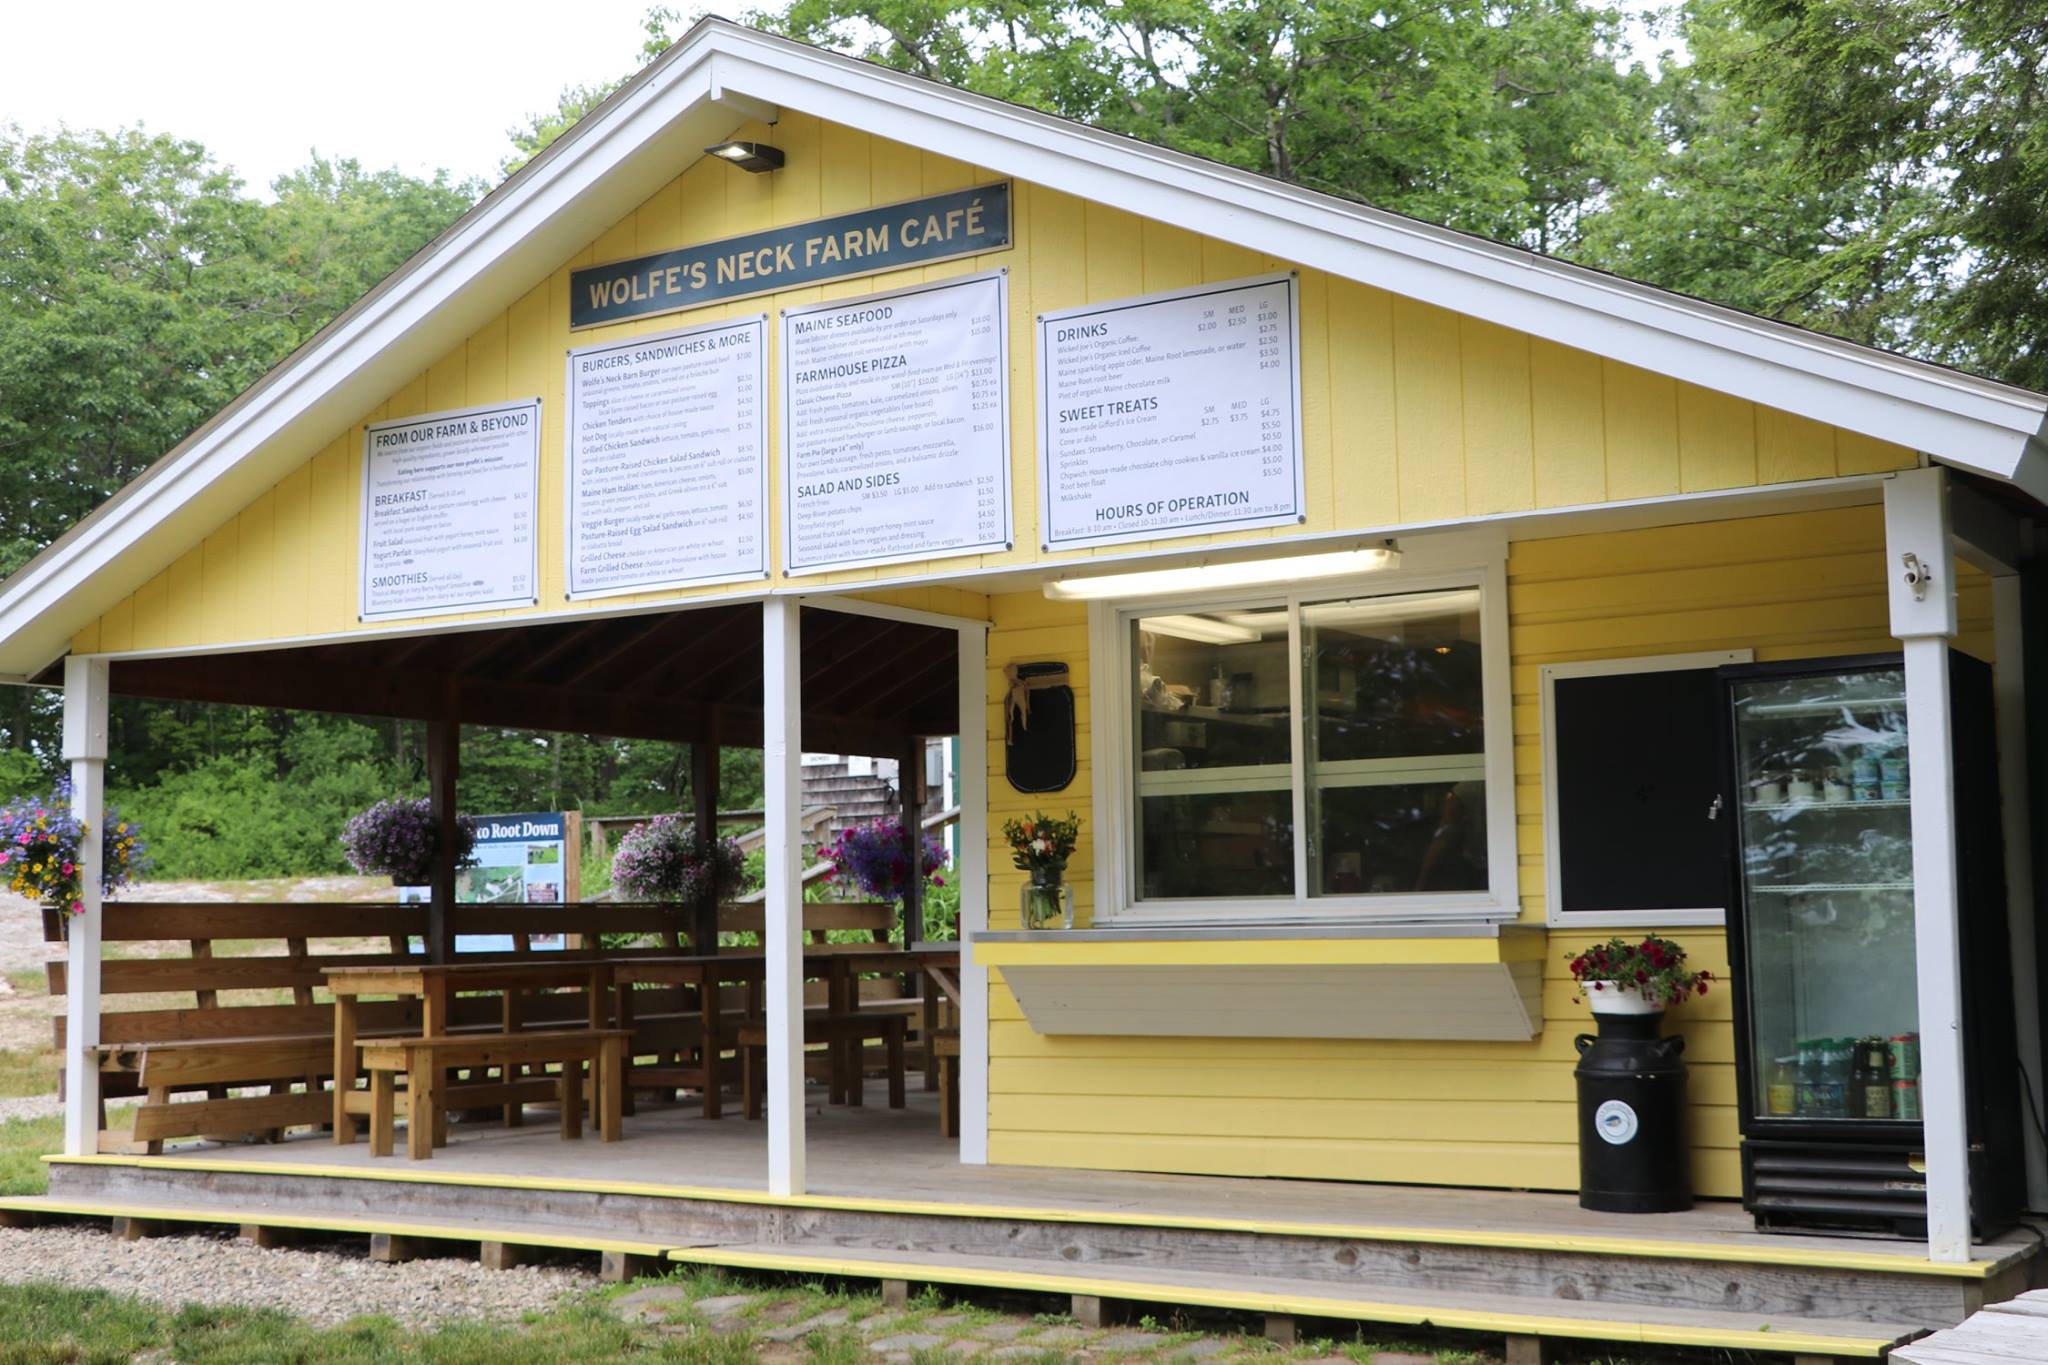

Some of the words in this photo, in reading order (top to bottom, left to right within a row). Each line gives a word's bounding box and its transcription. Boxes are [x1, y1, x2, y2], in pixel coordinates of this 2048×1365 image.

[589, 261, 707, 310] WOLFE'S
[716, 243, 796, 285] NECK
[805, 224, 890, 267] FARM
[900, 199, 986, 248] CAFÉ
[1229, 305, 1244, 314] MED
[796, 318, 833, 334] MAINE
[837, 307, 892, 327] SEAFOOD
[1198, 322, 1216, 331] $2.00
[1228, 317, 1246, 327] $2.50
[1258, 312, 1277, 322] $3.00
[1058, 323, 1107, 342] DRINKS
[1259, 324, 1277, 334] $2.75
[1259, 336, 1277, 345] $2.50
[583, 354, 632, 374] BURGERS,
[635, 341, 705, 363] SANDWICHES
[708, 339, 715, 350] &
[719, 332, 750, 348] MORE
[1260, 348, 1278, 358] $3.50
[796, 362, 868, 384] FARMHOUSE
[872, 355, 906, 371] PIZZA
[1260, 360, 1279, 370] $4.00
[606, 374, 620, 383] Neck
[623, 372, 637, 380] Barn
[640, 368, 660, 379] Burger
[1059, 405, 1104, 422] SWEET
[1108, 397, 1157, 415] TREATS
[1231, 401, 1247, 410] MED
[583, 421, 606, 430] Chicken
[608, 416, 631, 426] Tenders
[1202, 417, 1218, 426] $2.75
[1230, 413, 1248, 422] $3.75
[1261, 409, 1279, 418] $4.75
[377, 432, 408, 448] FROM
[411, 428, 433, 443] OUR
[436, 423, 466, 438] FARM
[470, 421, 477, 433] &
[482, 414, 528, 431] BEYOND
[1262, 421, 1280, 430] $5.50
[595, 433, 606, 442] Dog
[604, 441, 628, 451] Chicken
[630, 436, 660, 447] Sandwich
[1262, 432, 1281, 441] $0.50
[1262, 444, 1282, 453] $4.00
[1262, 456, 1281, 464] $5.00
[1263, 468, 1281, 476] $5.50
[798, 482, 834, 498] SALAD
[837, 478, 862, 492] AND
[866, 473, 899, 488] SIDES
[375, 490, 426, 506] BREAKFAST
[1096, 504, 1142, 520] HOURS
[1147, 501, 1164, 514] OF
[1168, 491, 1249, 512] OPERATION
[582, 520, 602, 530] Veggie
[604, 517, 624, 528] Burger
[630, 527, 640, 536] Egg
[643, 524, 660, 532] Salad
[662, 520, 692, 530] Sandwich
[603, 551, 625, 560] Cheese
[621, 561, 642, 570] Cheese
[372, 573, 427, 588] SMOOTHIES
[492, 823, 521, 838] Root
[522, 821, 559, 837] Down
